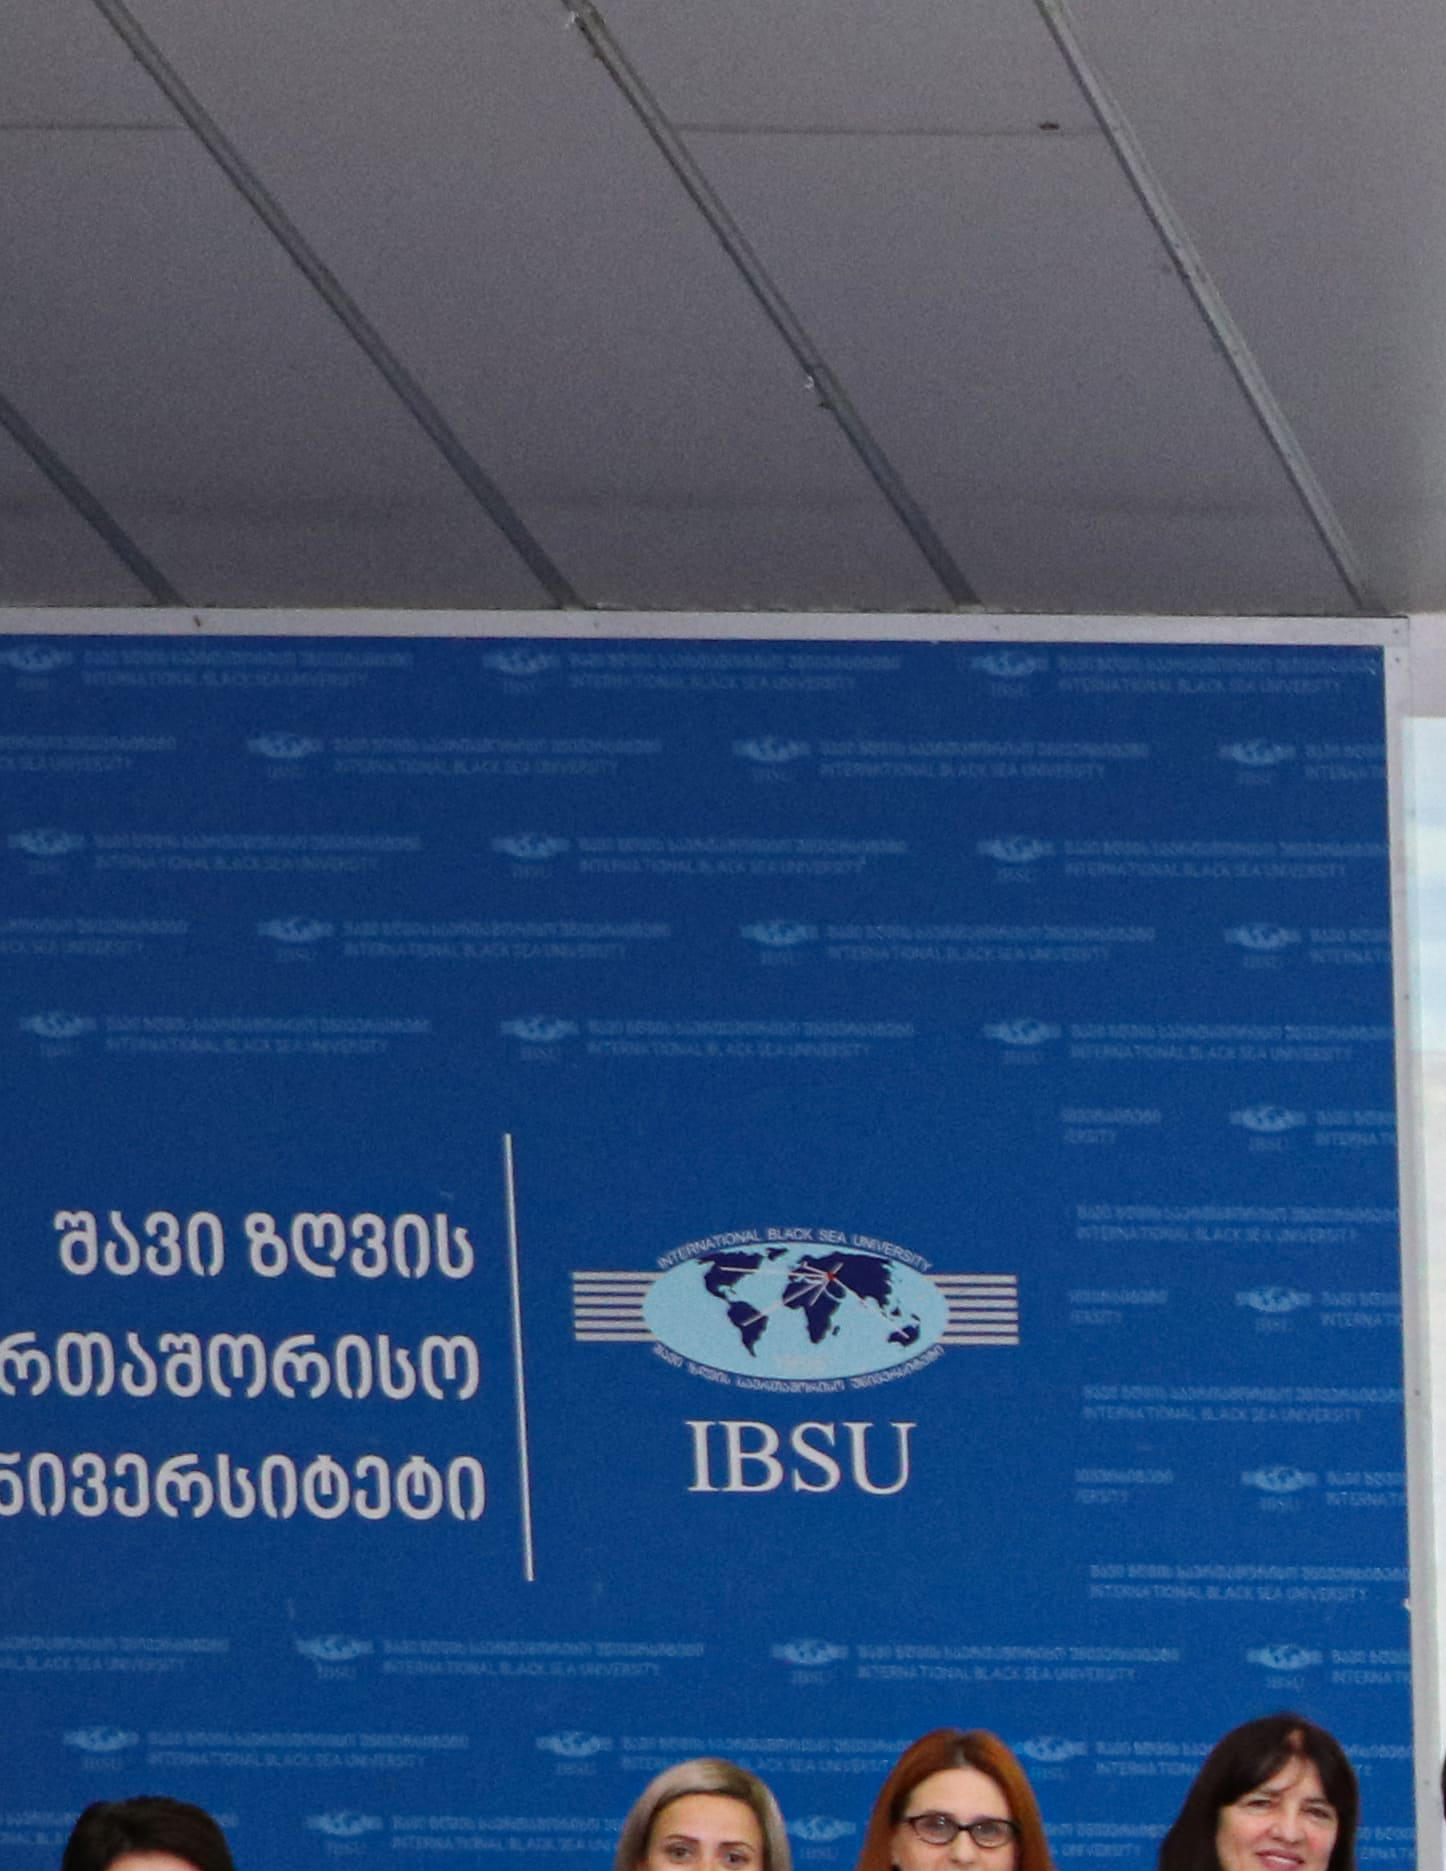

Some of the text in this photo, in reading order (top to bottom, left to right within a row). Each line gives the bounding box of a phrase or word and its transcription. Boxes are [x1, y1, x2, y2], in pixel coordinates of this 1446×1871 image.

[54, 1210, 475, 1280] შავი ზღვის
[657, 1227, 933, 1271] INTERNATIONAL BLACK SEA UNIVERSITY
[685, 1420, 918, 1495] IBSU
